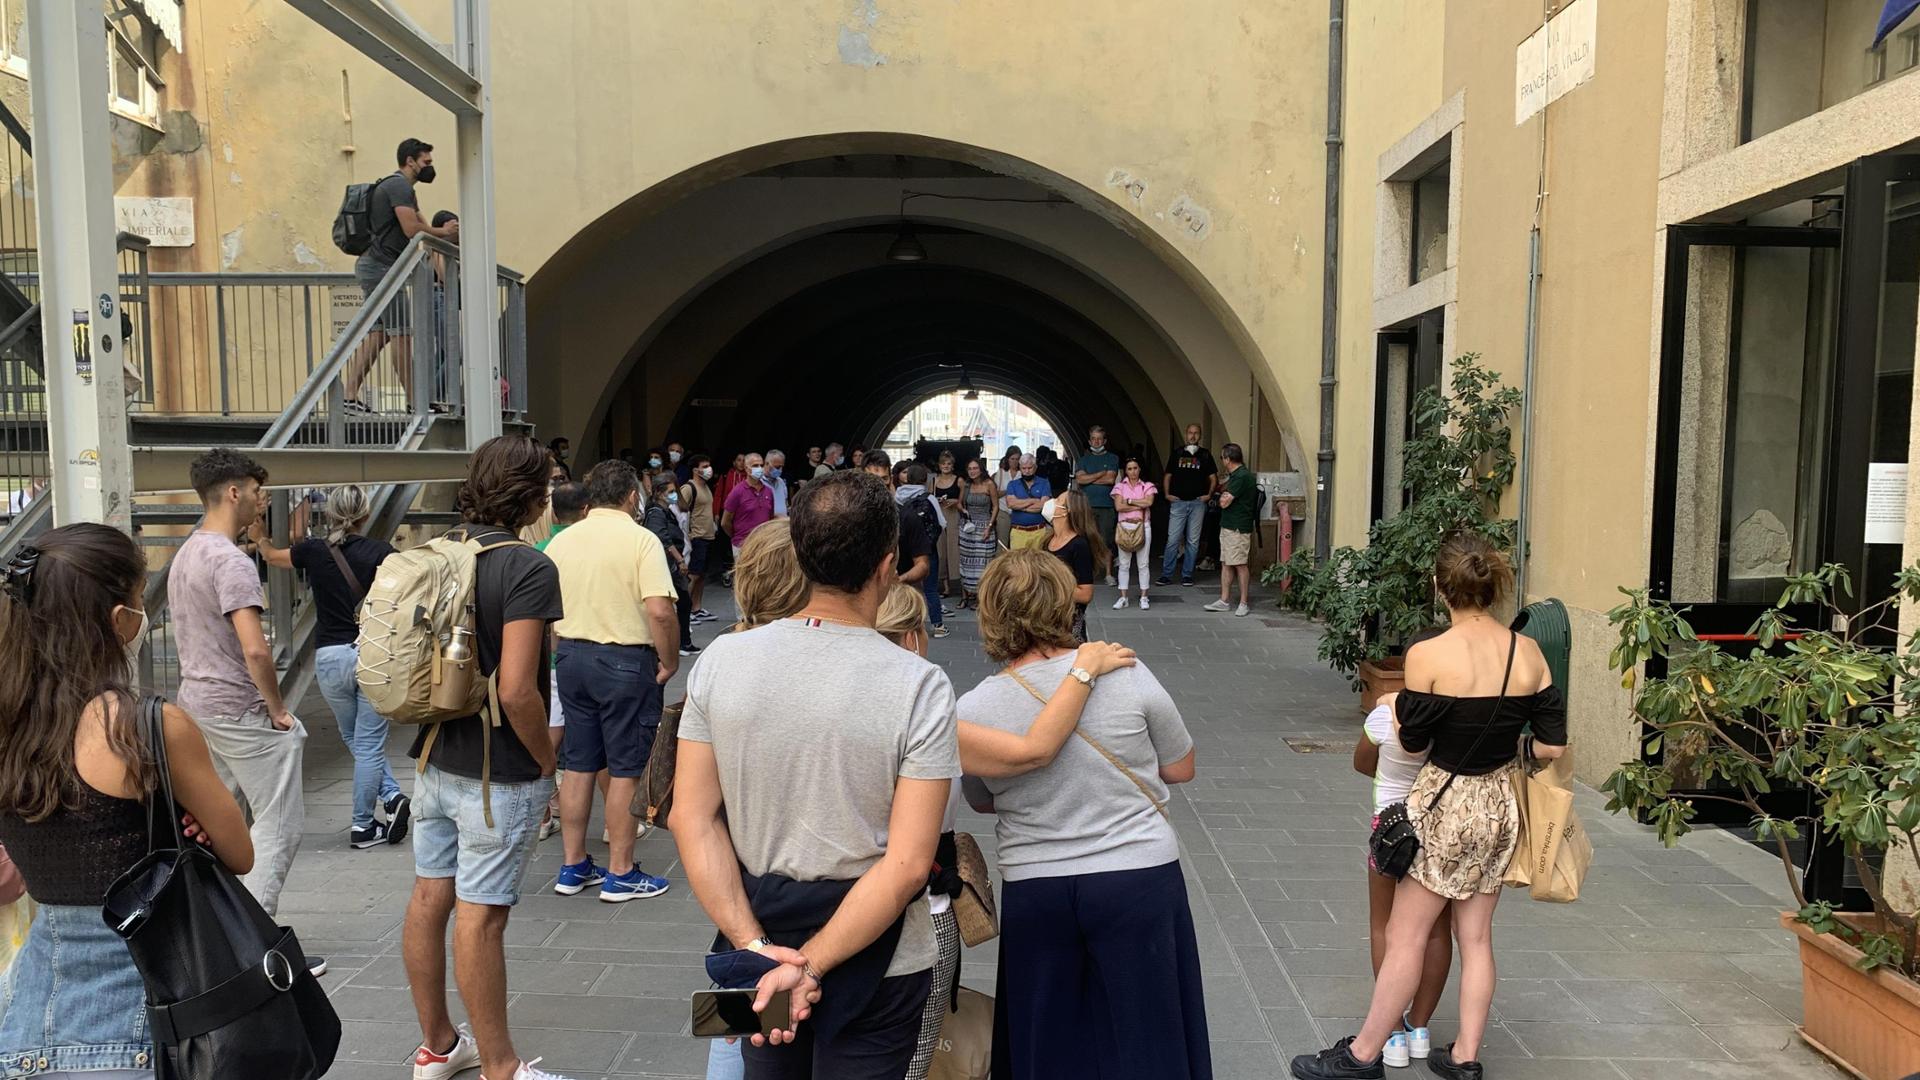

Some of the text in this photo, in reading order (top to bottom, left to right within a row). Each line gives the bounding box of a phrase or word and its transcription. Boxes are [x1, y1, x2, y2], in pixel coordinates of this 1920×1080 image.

[1563, 39, 1590, 71] VIVALDI
[121, 207, 148, 217] VIA
[128, 225, 189, 236] IMPERIALE
[1538, 821, 1556, 874] bershka.com
